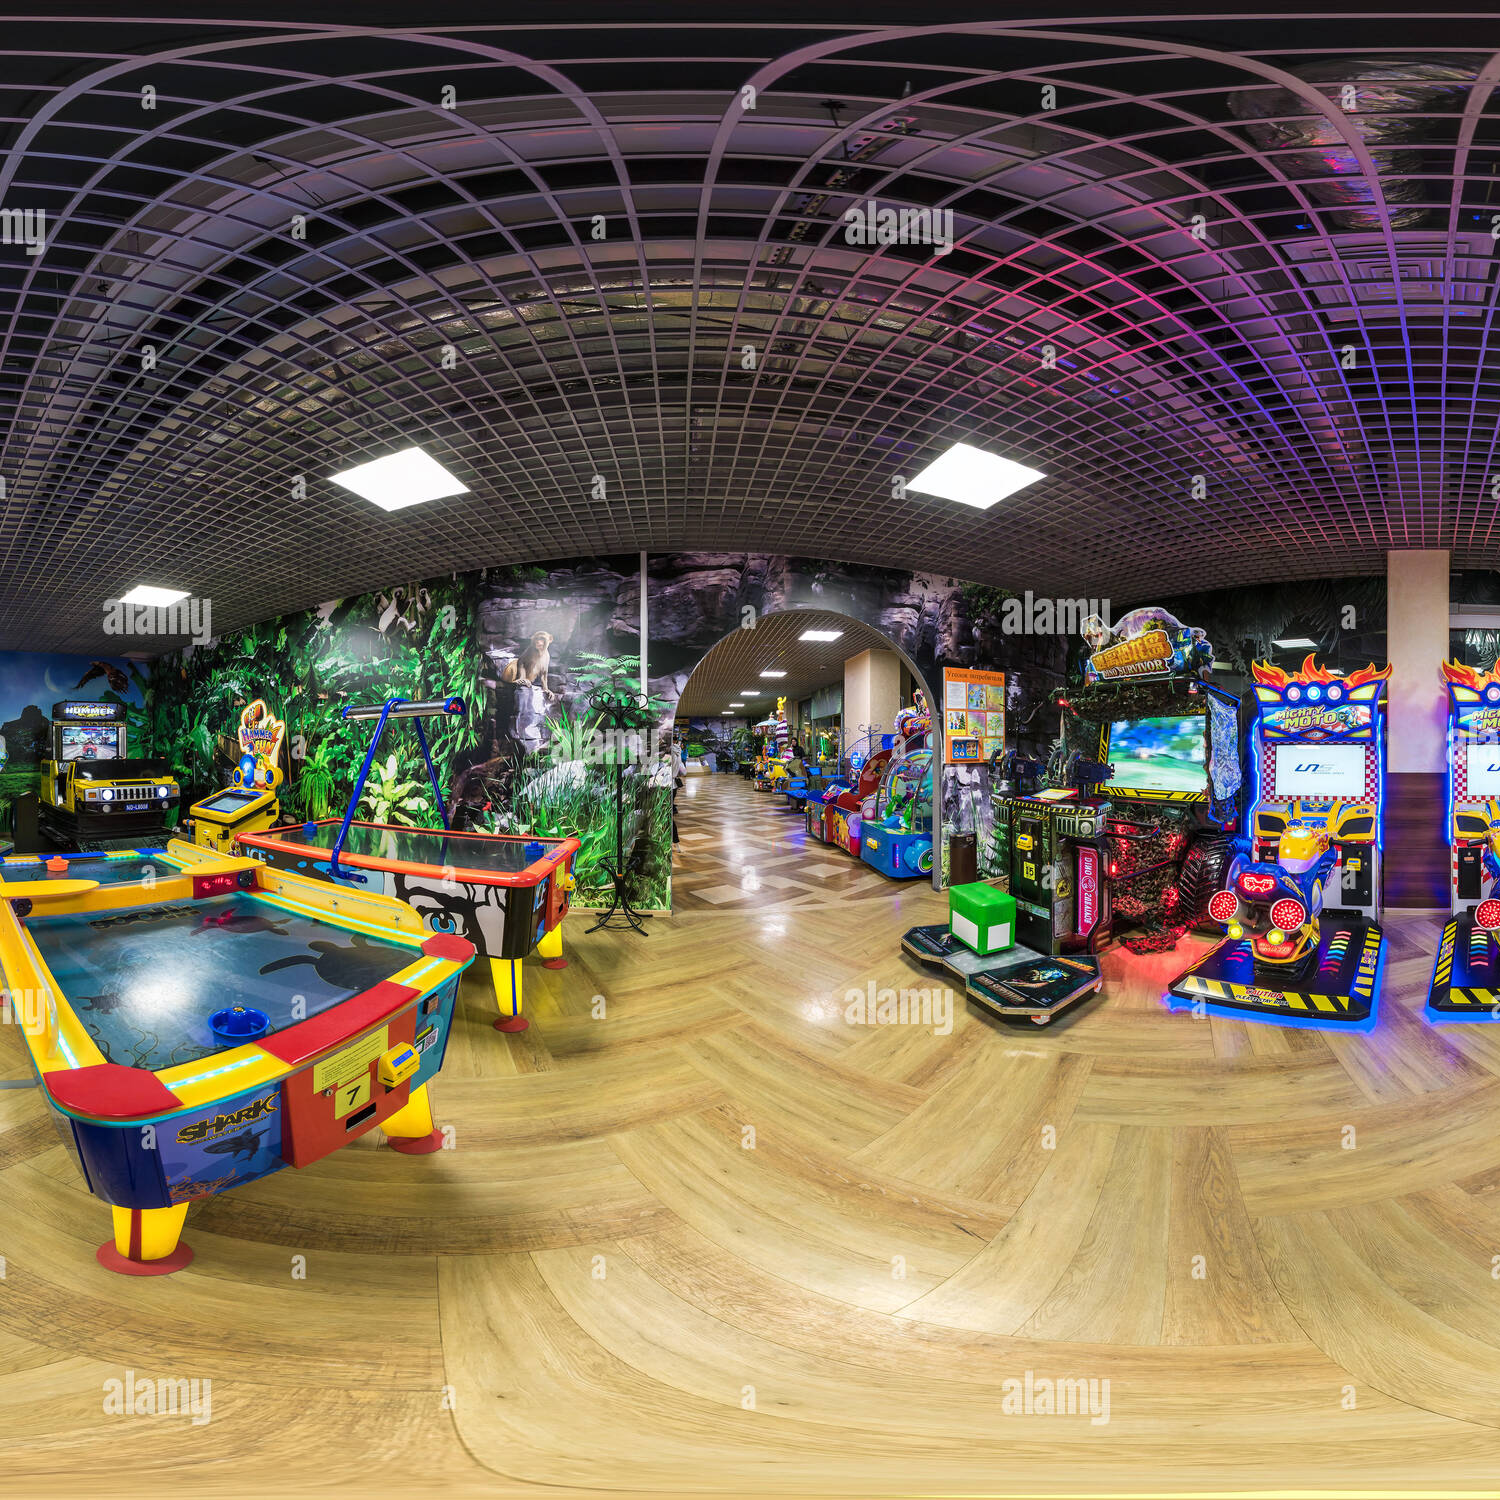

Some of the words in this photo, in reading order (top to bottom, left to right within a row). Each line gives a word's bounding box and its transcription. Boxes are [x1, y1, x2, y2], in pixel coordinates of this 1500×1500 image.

[1119, 660, 1165, 675] SURVIVOR
[65, 706, 115, 715] HUMMER
[1275, 705, 1325, 720] MIGHTY
[1284, 712, 1338, 730] MOTO
[241, 728, 273, 742] HAMMER
[254, 740, 276, 755] FUN
[1024, 865, 1034, 877] 15
[1245, 988, 1284, 999] CAUTION
[346, 1085, 360, 1106] 7
[176, 1091, 280, 1143] SHARK
